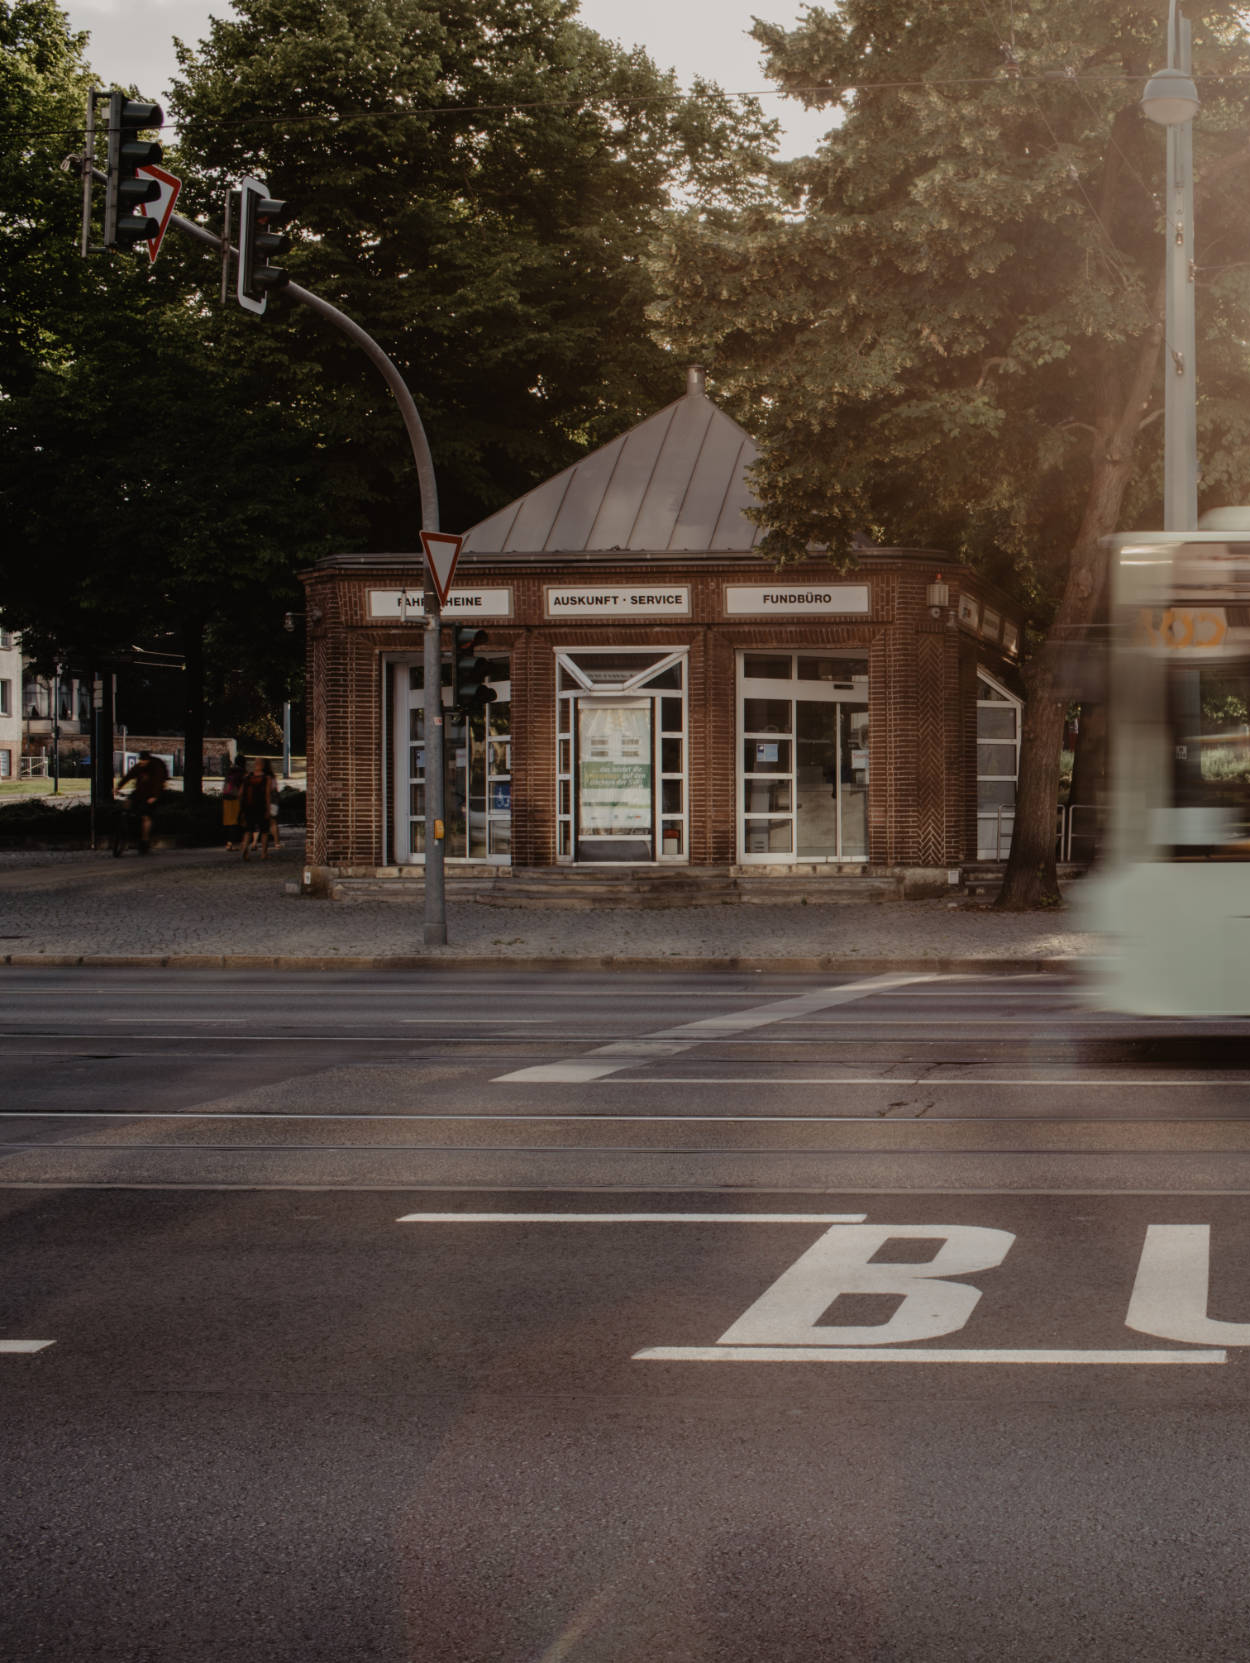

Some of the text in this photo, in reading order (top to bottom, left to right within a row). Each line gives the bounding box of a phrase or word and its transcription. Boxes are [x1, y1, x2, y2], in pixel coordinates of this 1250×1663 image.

[397, 596, 482, 607] FAHHEINE
[553, 594, 683, 606] AUSKUNFT SERVICE
[763, 591, 832, 604] FUNDBÜRO
